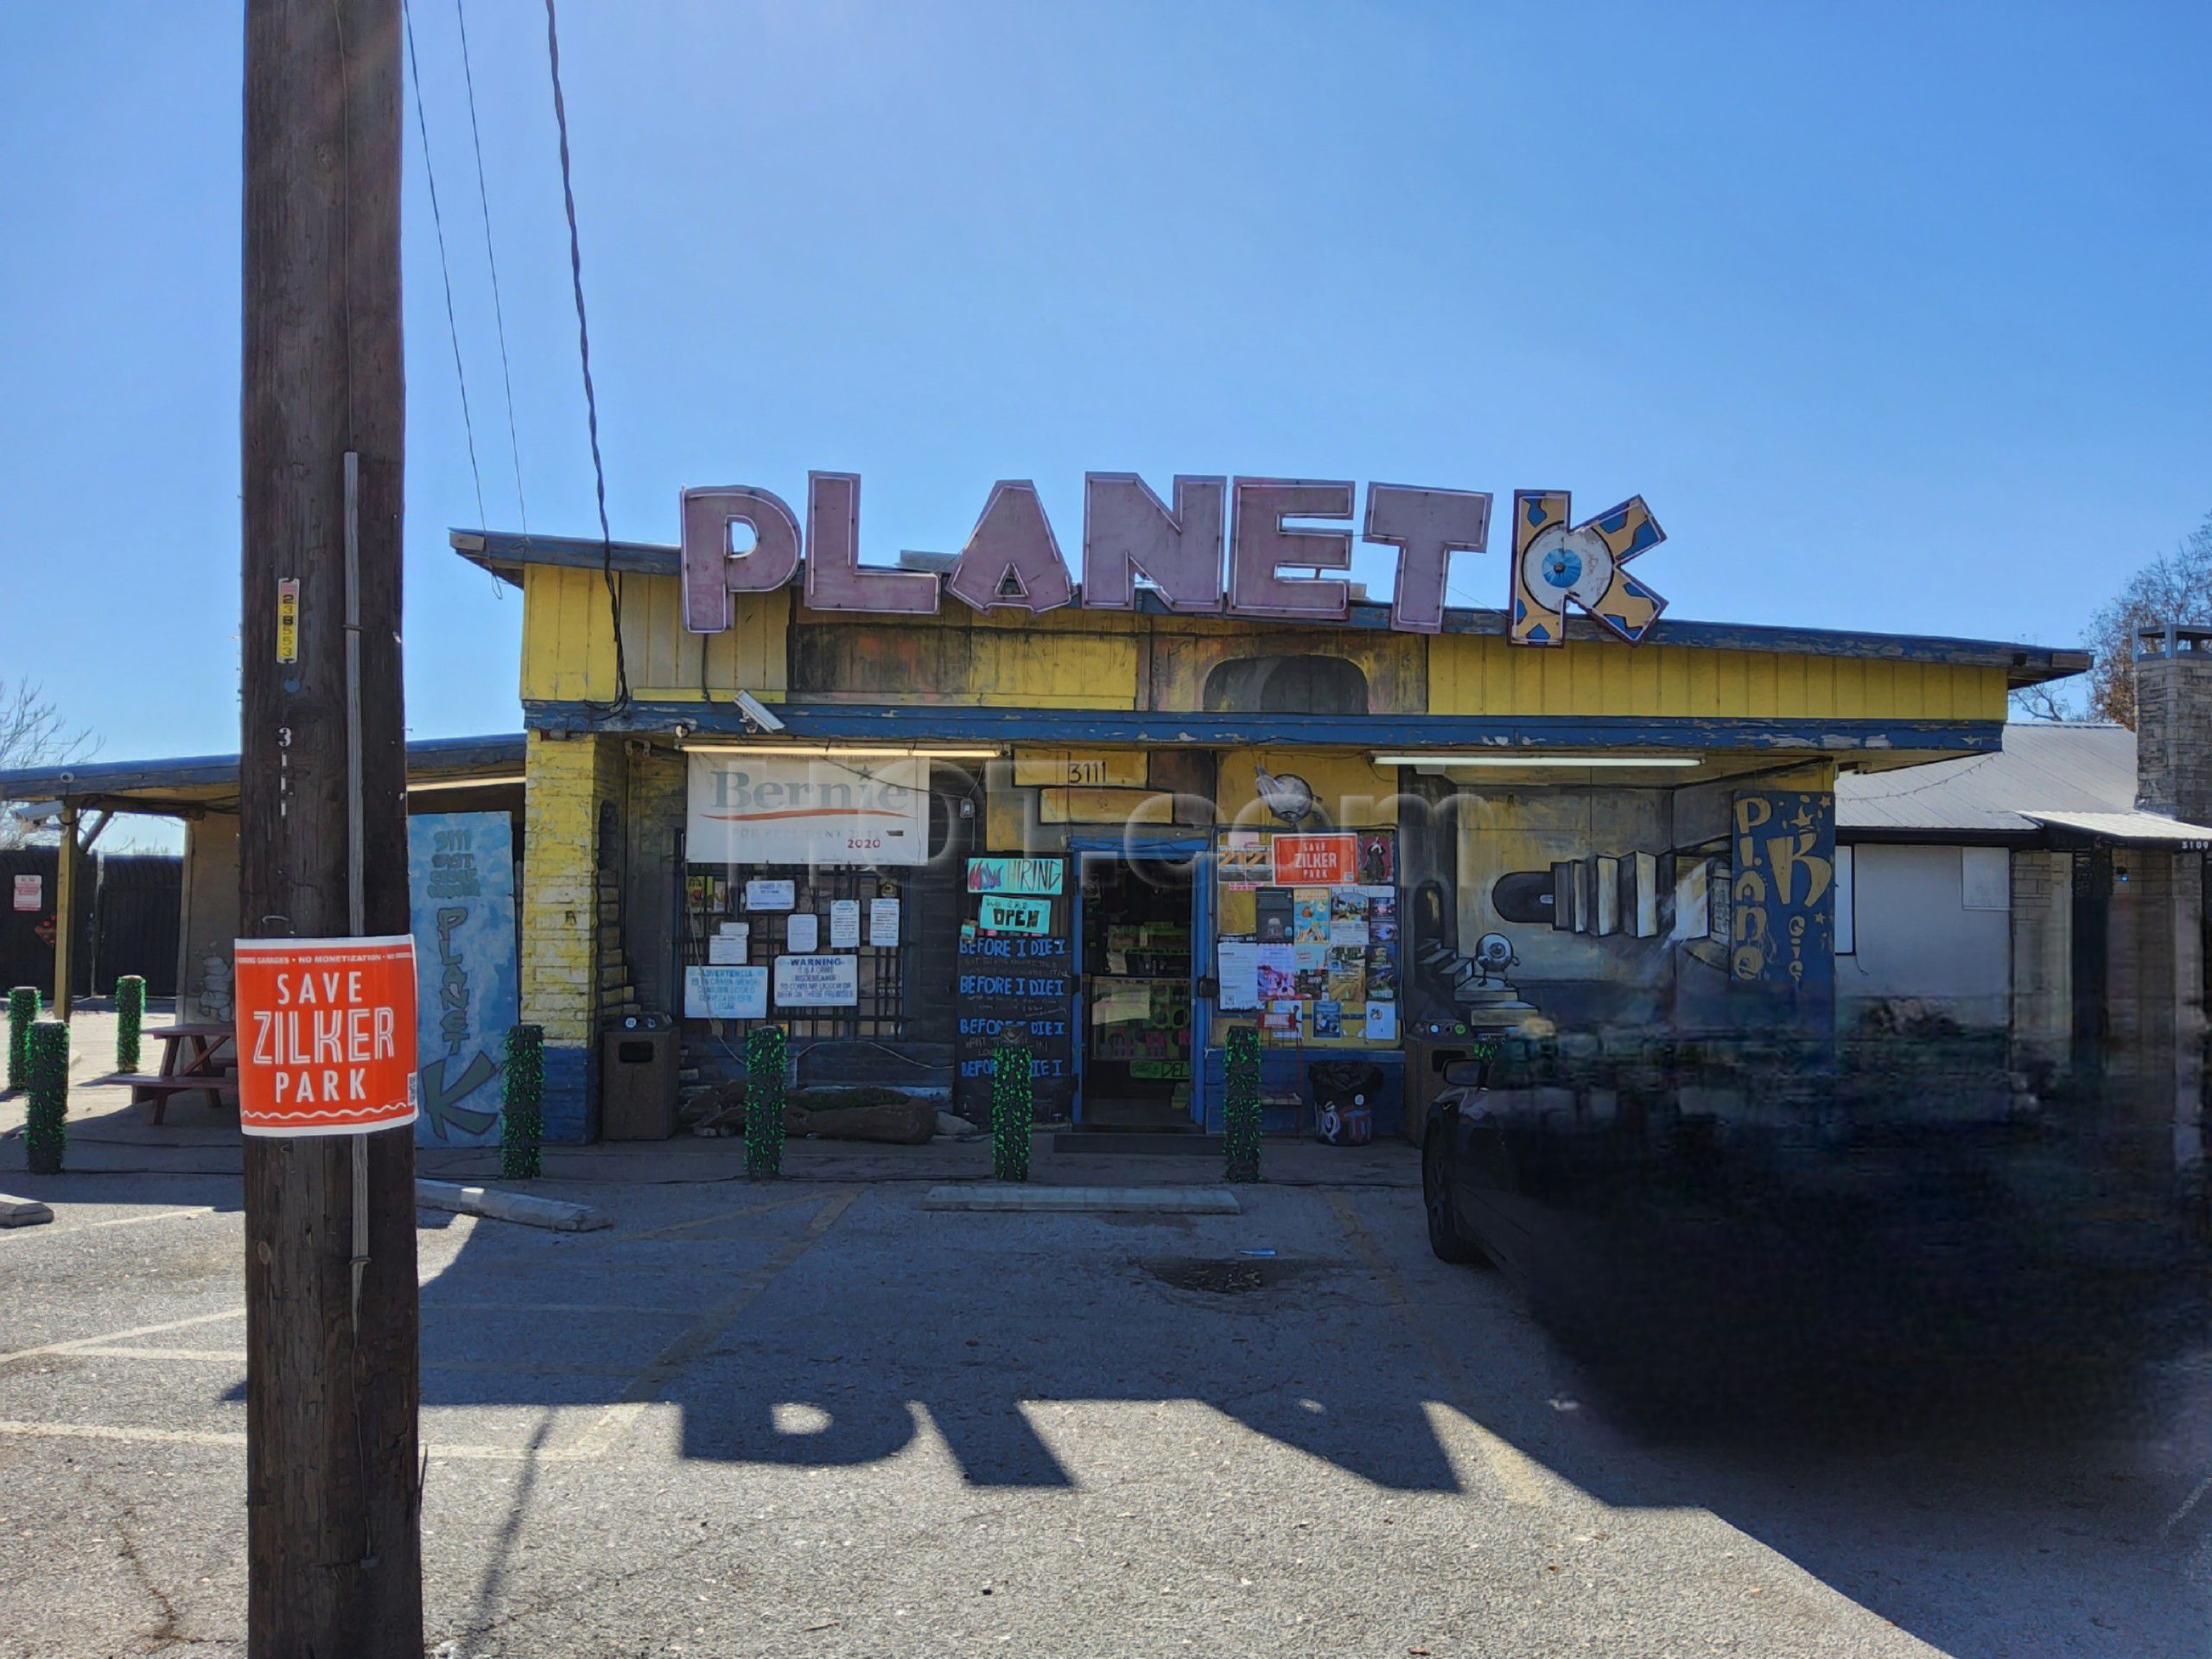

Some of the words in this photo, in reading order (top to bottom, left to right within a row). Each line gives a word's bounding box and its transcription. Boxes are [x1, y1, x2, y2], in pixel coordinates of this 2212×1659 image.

[680, 469, 1493, 635] PLANET
[1508, 490, 1668, 647] K
[1068, 761, 1106, 784] 3111
[710, 769, 907, 809] Bernie
[847, 838, 881, 849] 2020
[1302, 841, 1326, 852] SAVE
[1294, 852, 1338, 869] ZILKER
[1006, 860, 1062, 892] HIRING
[1303, 868, 1328, 879] PARK
[993, 907, 1039, 929] OPEN
[959, 938, 1011, 957] BEFORE
[1017, 938, 1027, 957] I
[1031, 938, 1052, 957] DIE
[298, 956, 313, 964] NO
[314, 954, 382, 963] MONETIZATION
[276, 970, 363, 1005] SAVE
[436, 906, 470, 1056] PLANET
[960, 976, 1012, 996] BEFORE
[1015, 977, 1026, 995] I
[1029, 979, 1053, 996] DIE
[1054, 979, 1065, 995] I
[252, 1006, 396, 1065] ZILKER
[1031, 1021, 1053, 1036] DIE
[275, 1067, 366, 1104] PARK
[422, 1050, 499, 1141] K
